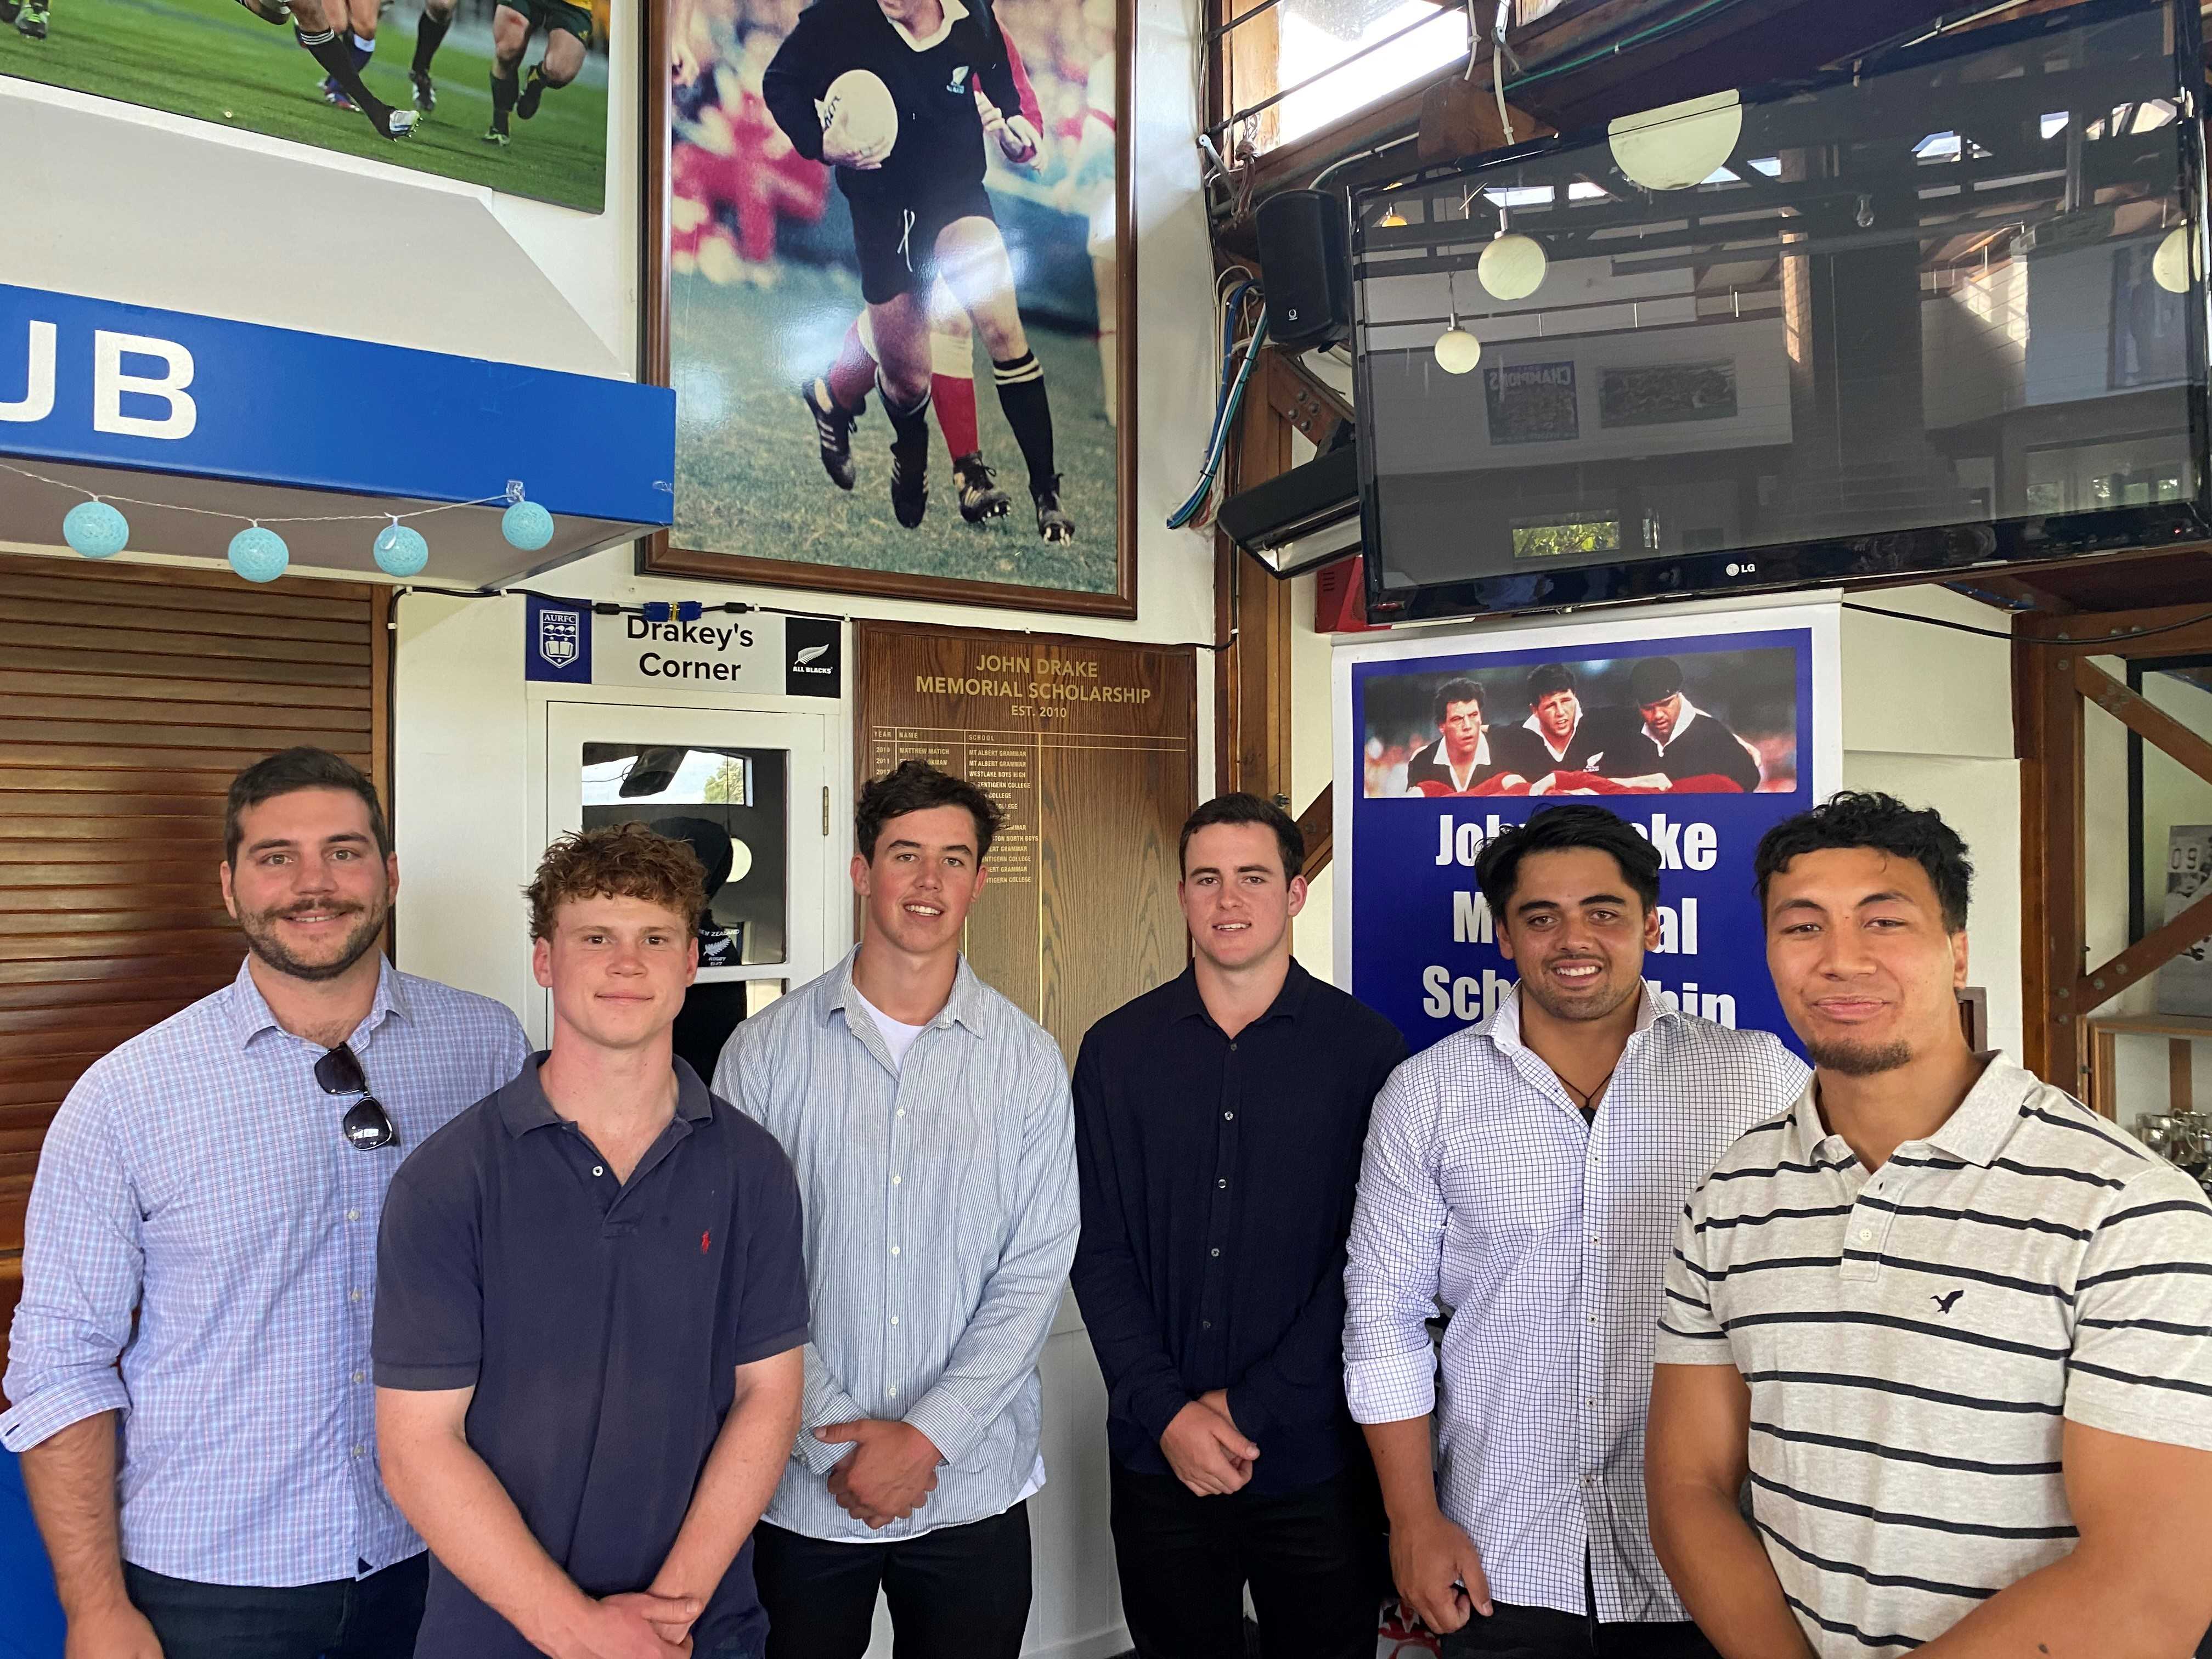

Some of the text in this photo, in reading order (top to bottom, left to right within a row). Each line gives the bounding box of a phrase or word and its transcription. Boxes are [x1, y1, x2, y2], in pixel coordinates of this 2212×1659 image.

[544, 614, 575, 623] AURFC
[627, 614, 754, 652] Drakey's
[639, 652, 741, 681] Corner
[975, 654, 1098, 678] JOHN DRAKE
[916, 675, 1151, 704] MEMORIAL SCHOLARSHIP
[1011, 705, 1067, 718] EST. 2010
